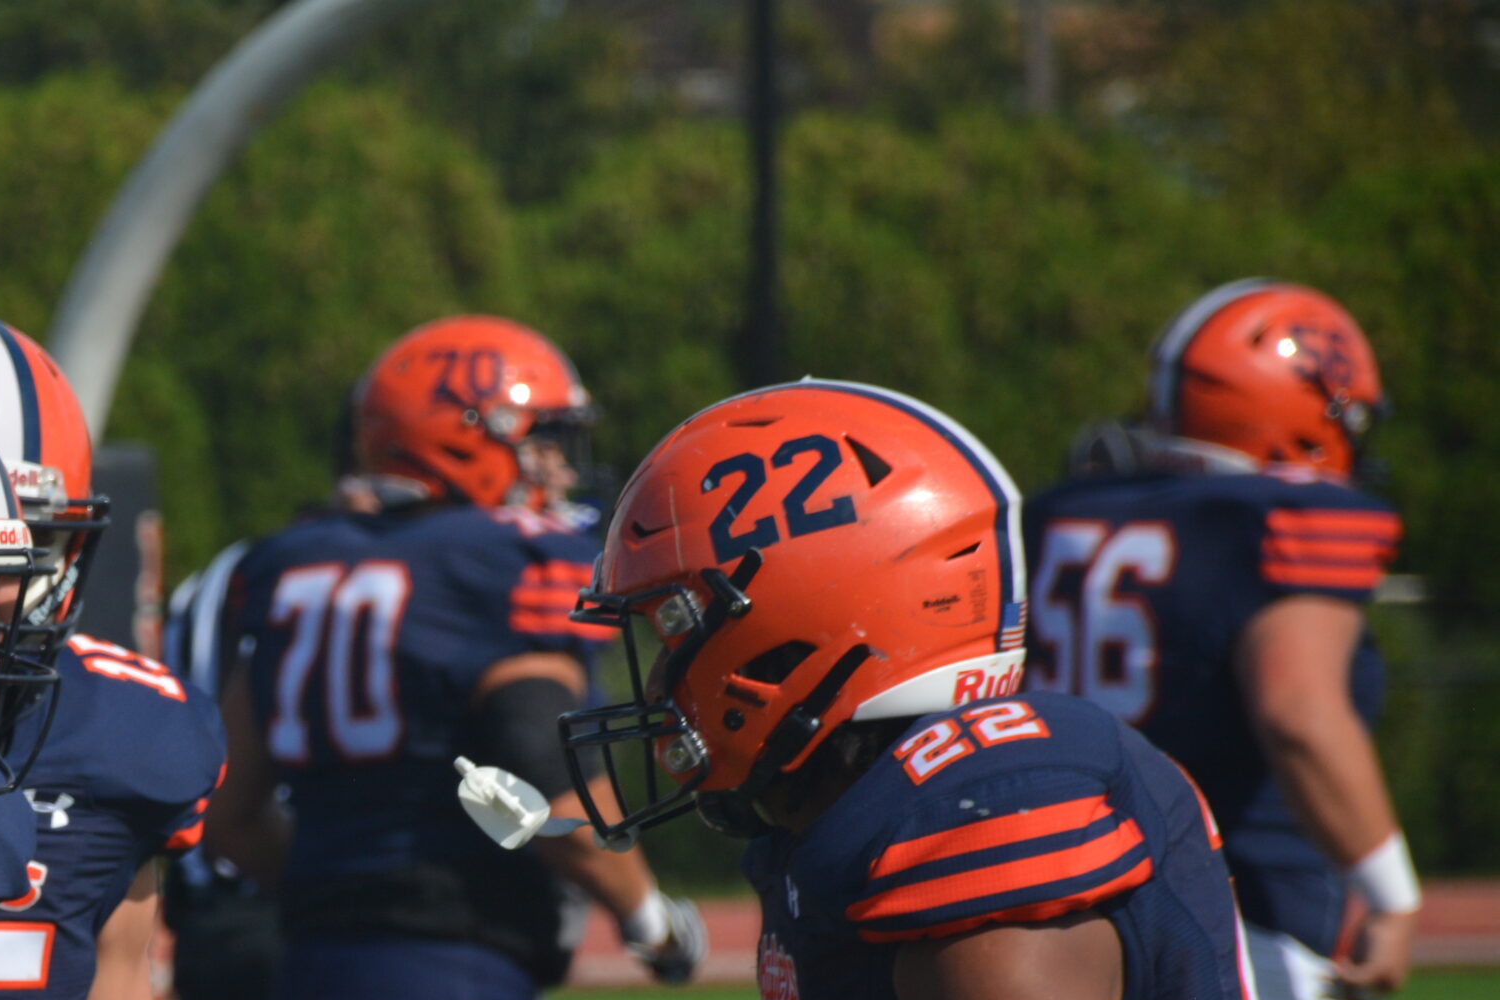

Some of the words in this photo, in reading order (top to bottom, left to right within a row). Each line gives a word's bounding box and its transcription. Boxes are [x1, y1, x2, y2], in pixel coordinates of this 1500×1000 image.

[426, 349, 504, 403] 70
[701, 433, 858, 565] 22
[267, 560, 413, 764] 70
[1022, 516, 1180, 730] 56
[893, 700, 1052, 787] 22
